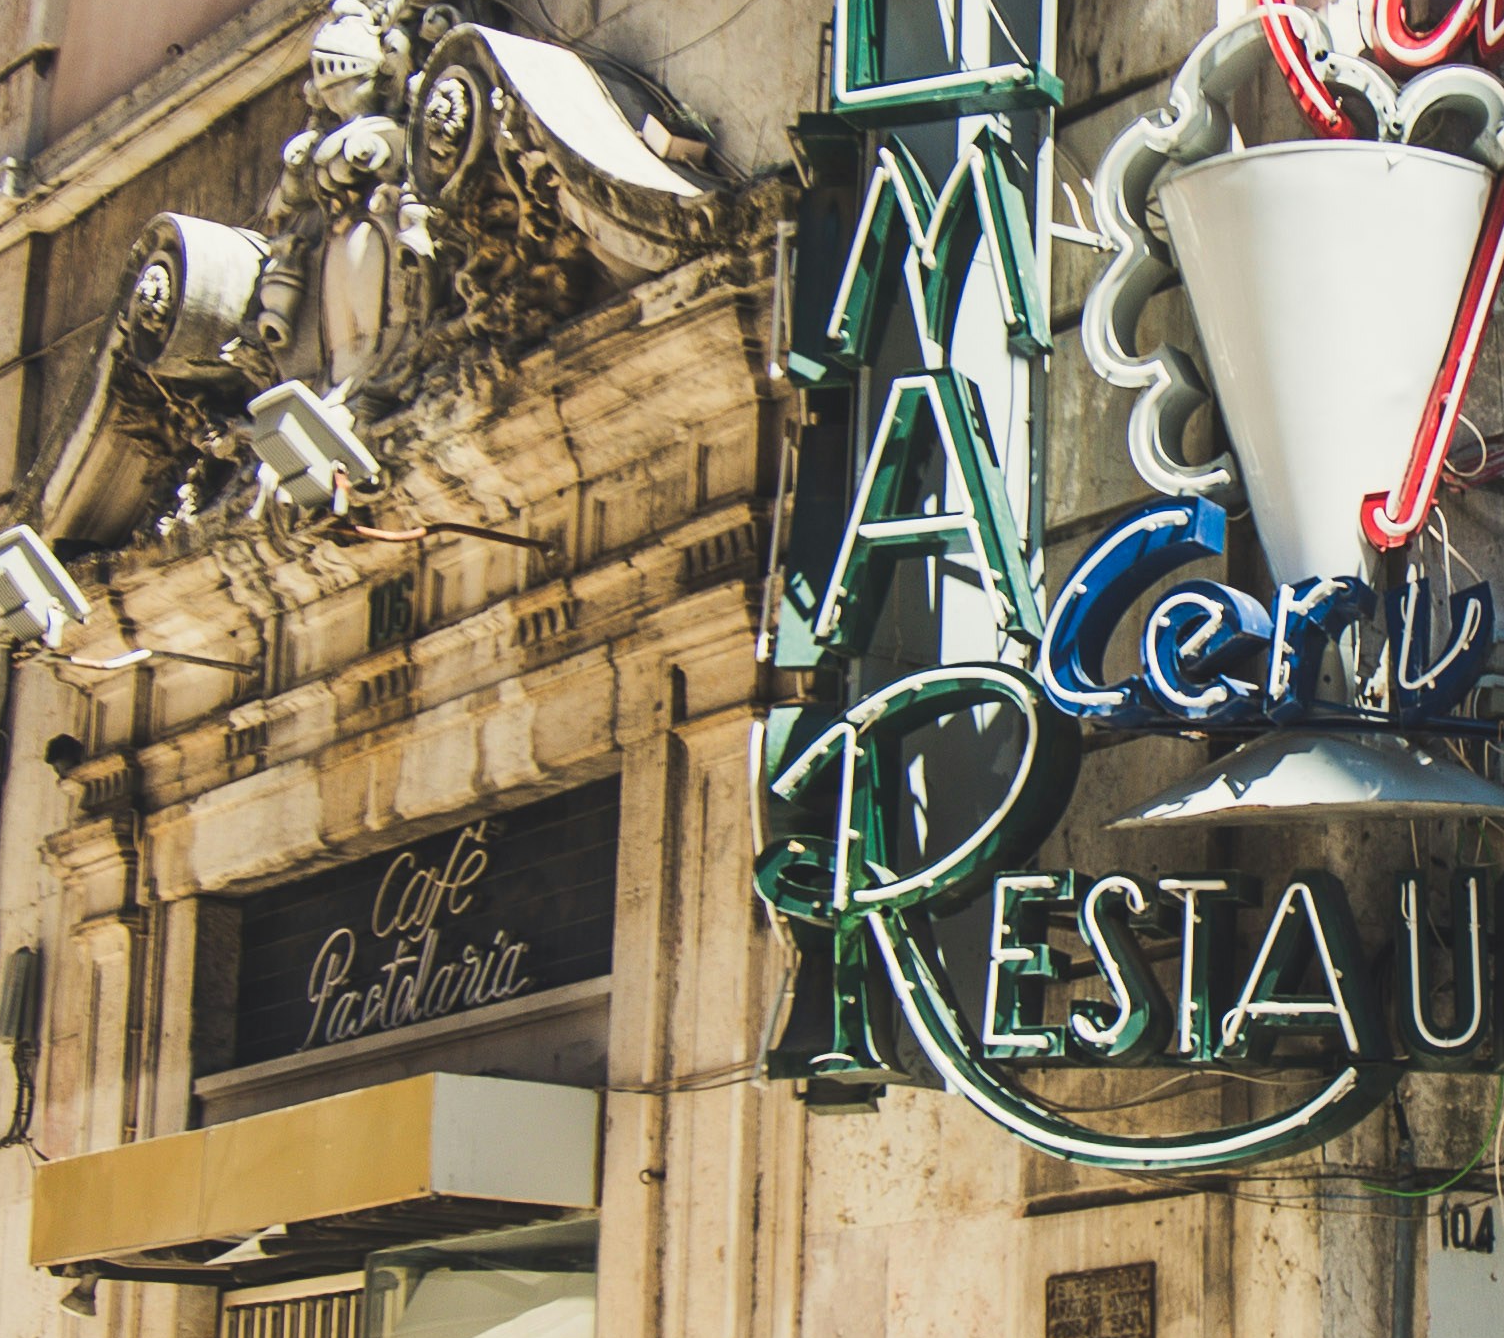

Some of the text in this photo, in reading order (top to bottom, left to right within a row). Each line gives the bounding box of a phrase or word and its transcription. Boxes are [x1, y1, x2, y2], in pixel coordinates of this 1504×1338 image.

[372, 821, 488, 942] Café
[296, 927, 530, 1051] Pastelaria
[1440, 1198, 1496, 1254] 104
